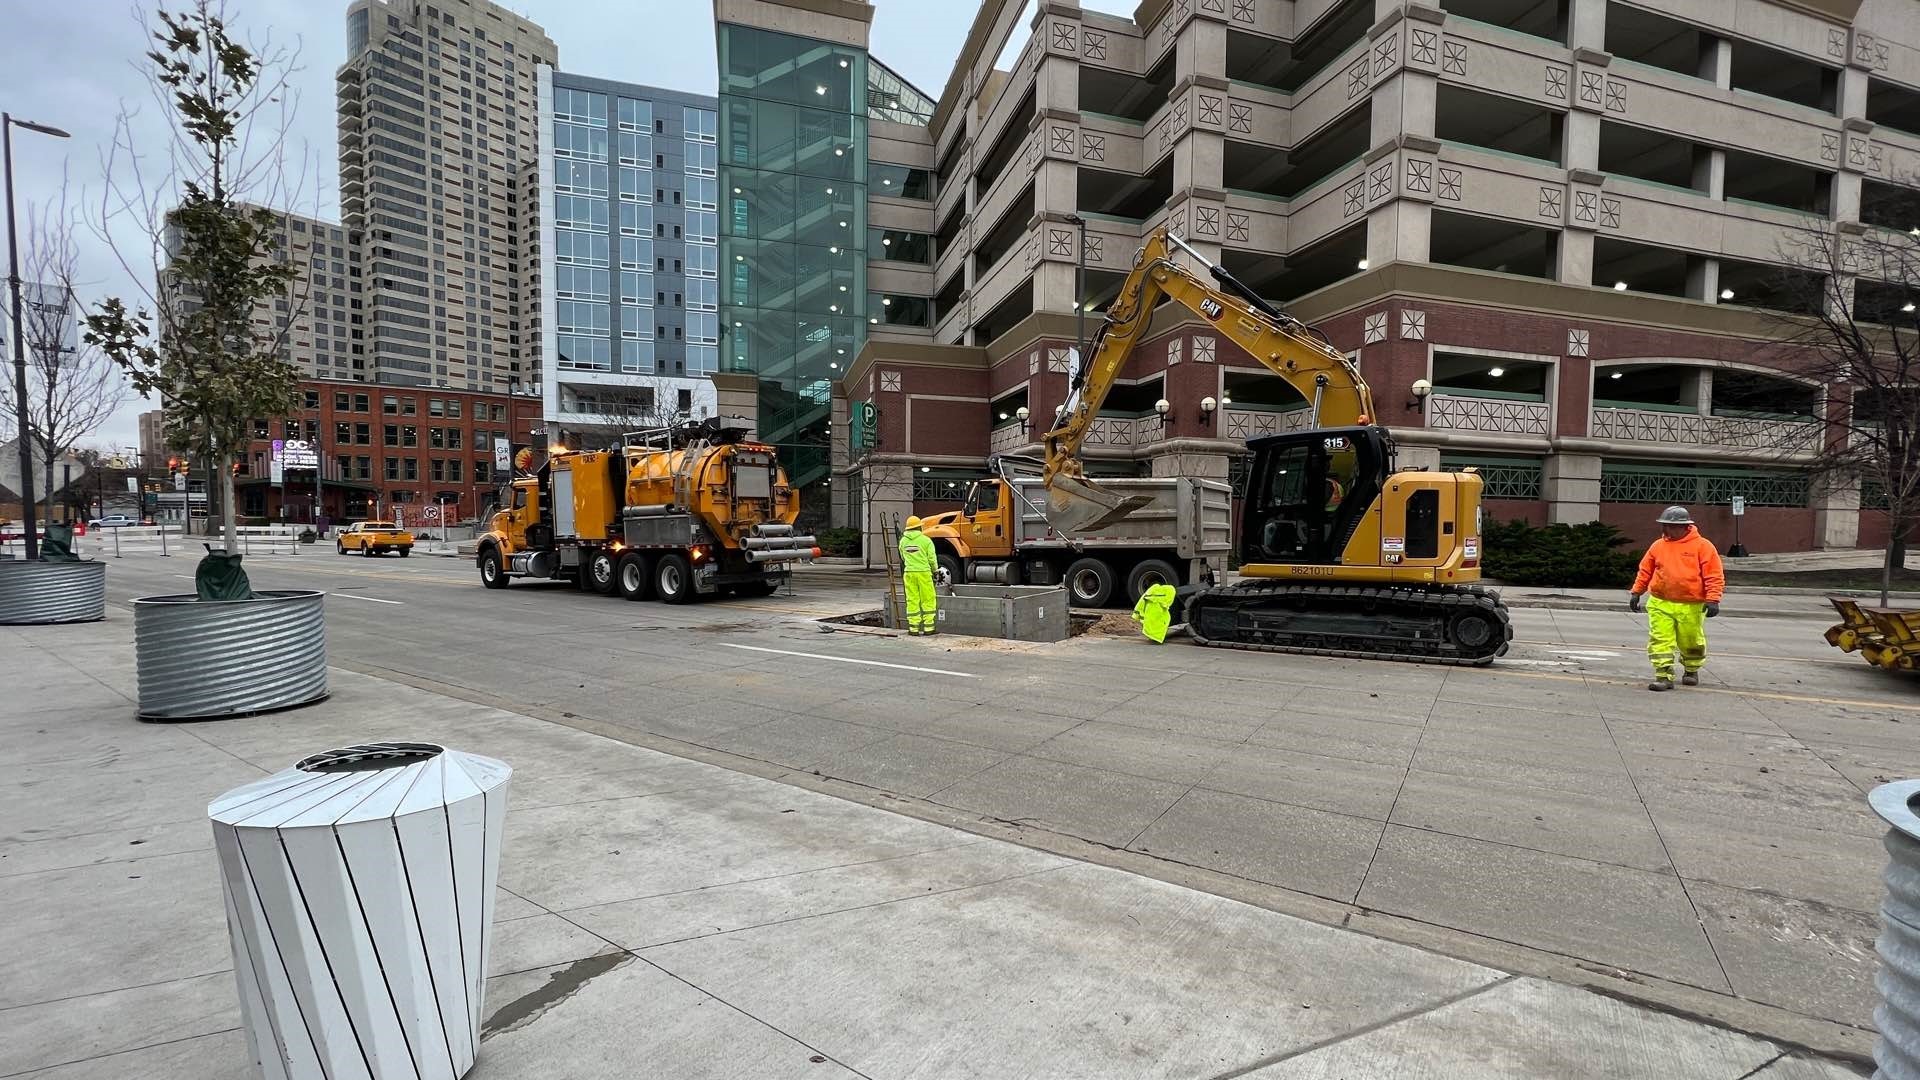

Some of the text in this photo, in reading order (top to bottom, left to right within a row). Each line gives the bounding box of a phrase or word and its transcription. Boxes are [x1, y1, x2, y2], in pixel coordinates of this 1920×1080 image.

[1200, 298, 1222, 317] CAT
[865, 406, 873, 422] P
[1324, 437, 1343, 448] 315
[1385, 554, 1400, 562] CAT
